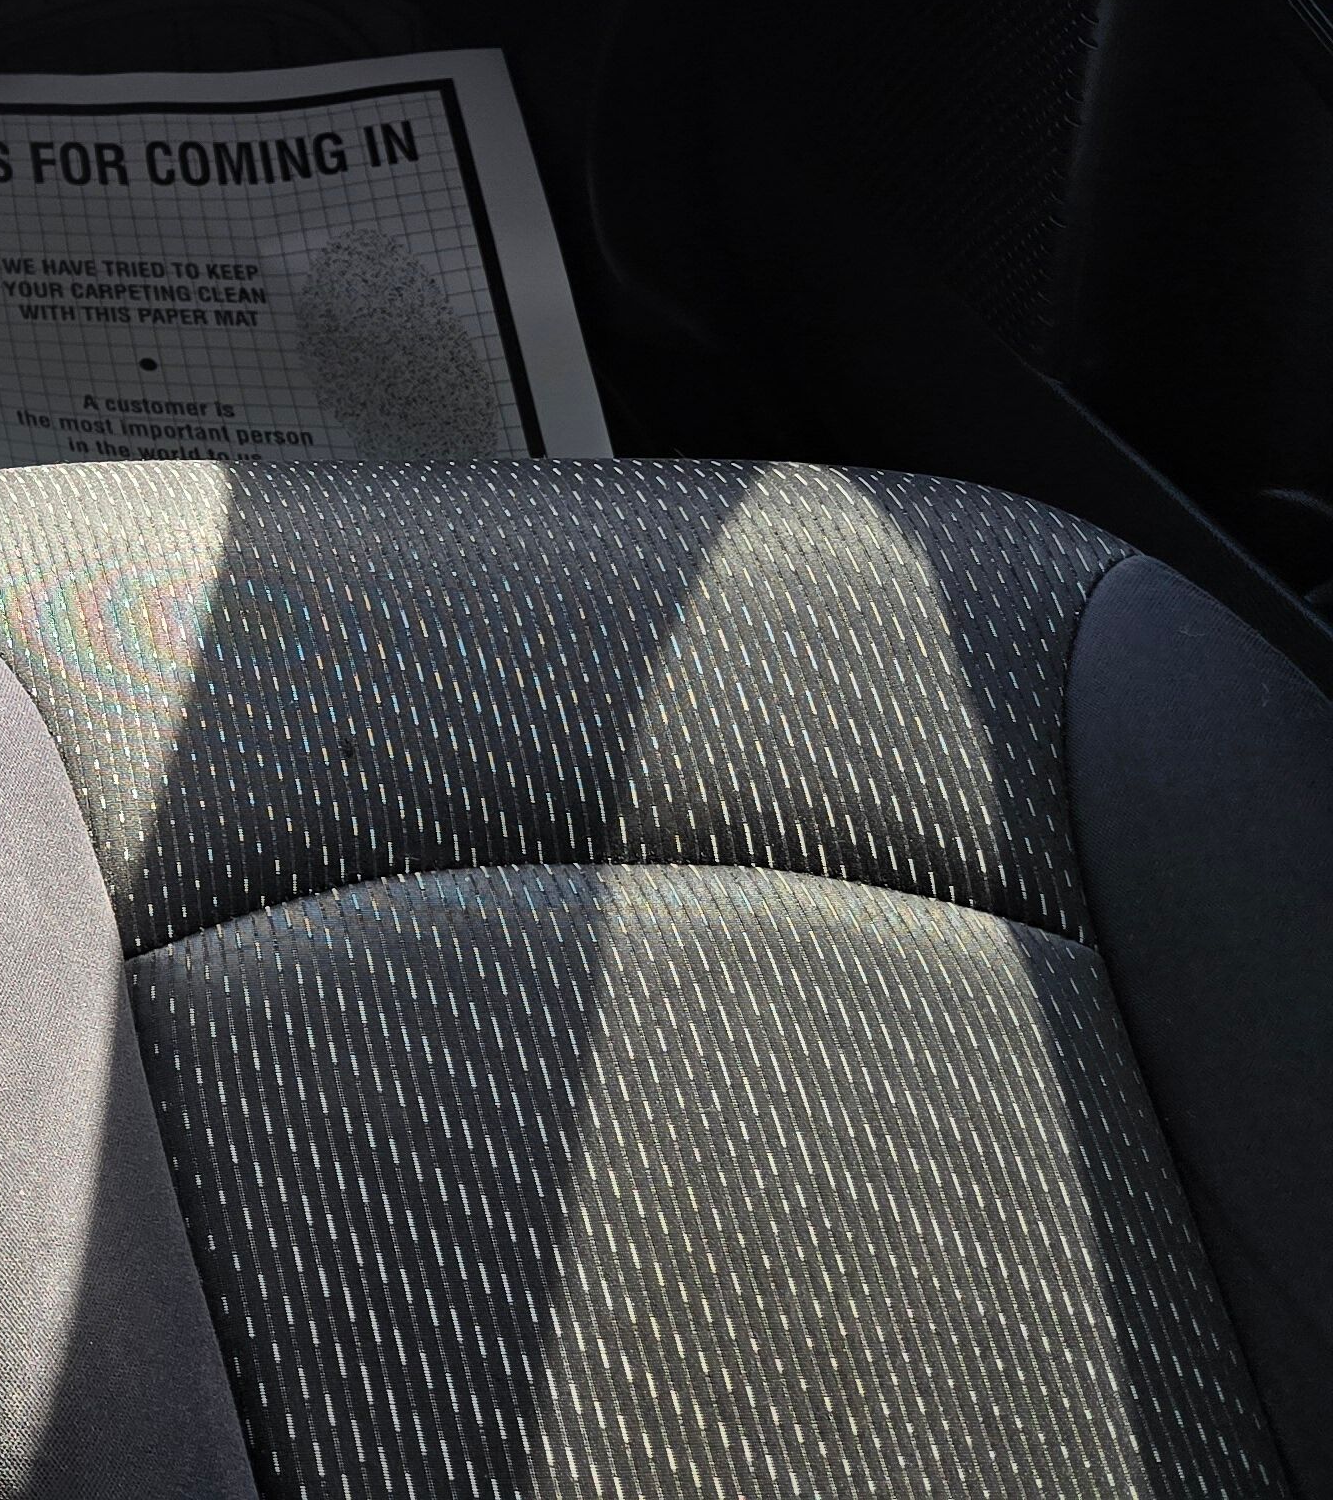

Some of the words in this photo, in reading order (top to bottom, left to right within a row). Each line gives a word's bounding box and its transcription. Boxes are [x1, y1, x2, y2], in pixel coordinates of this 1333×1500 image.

[31, 140, 129, 187] FOR
[148, 132, 348, 188] COMING
[363, 119, 420, 168] IN
[2, 256, 37, 276] WE
[42, 258, 97, 278] HAVE
[102, 260, 165, 280] TRIED
[170, 262, 199, 281] TO
[206, 262, 259, 282] KEEP
[4, 281, 64, 300] YOUR
[70, 283, 192, 303] CARPETING
[198, 286, 266, 305] CLEAN
[20, 303, 78, 323] WITH
[82, 304, 131, 324] THIS
[137, 306, 209, 326] PAPER
[215, 308, 259, 328] MAT
[84, 394, 100, 412] A
[105, 396, 207, 417] customer
[215, 400, 236, 418] is
[16, 409, 51, 429] the
[58, 414, 113, 435] most
[120, 420, 230, 443] important
[235, 427, 314, 447] person
[68, 436, 89, 454] in
[95, 437, 130, 459] the
[135, 443, 200, 461] world
[206, 446, 230, 461] to
